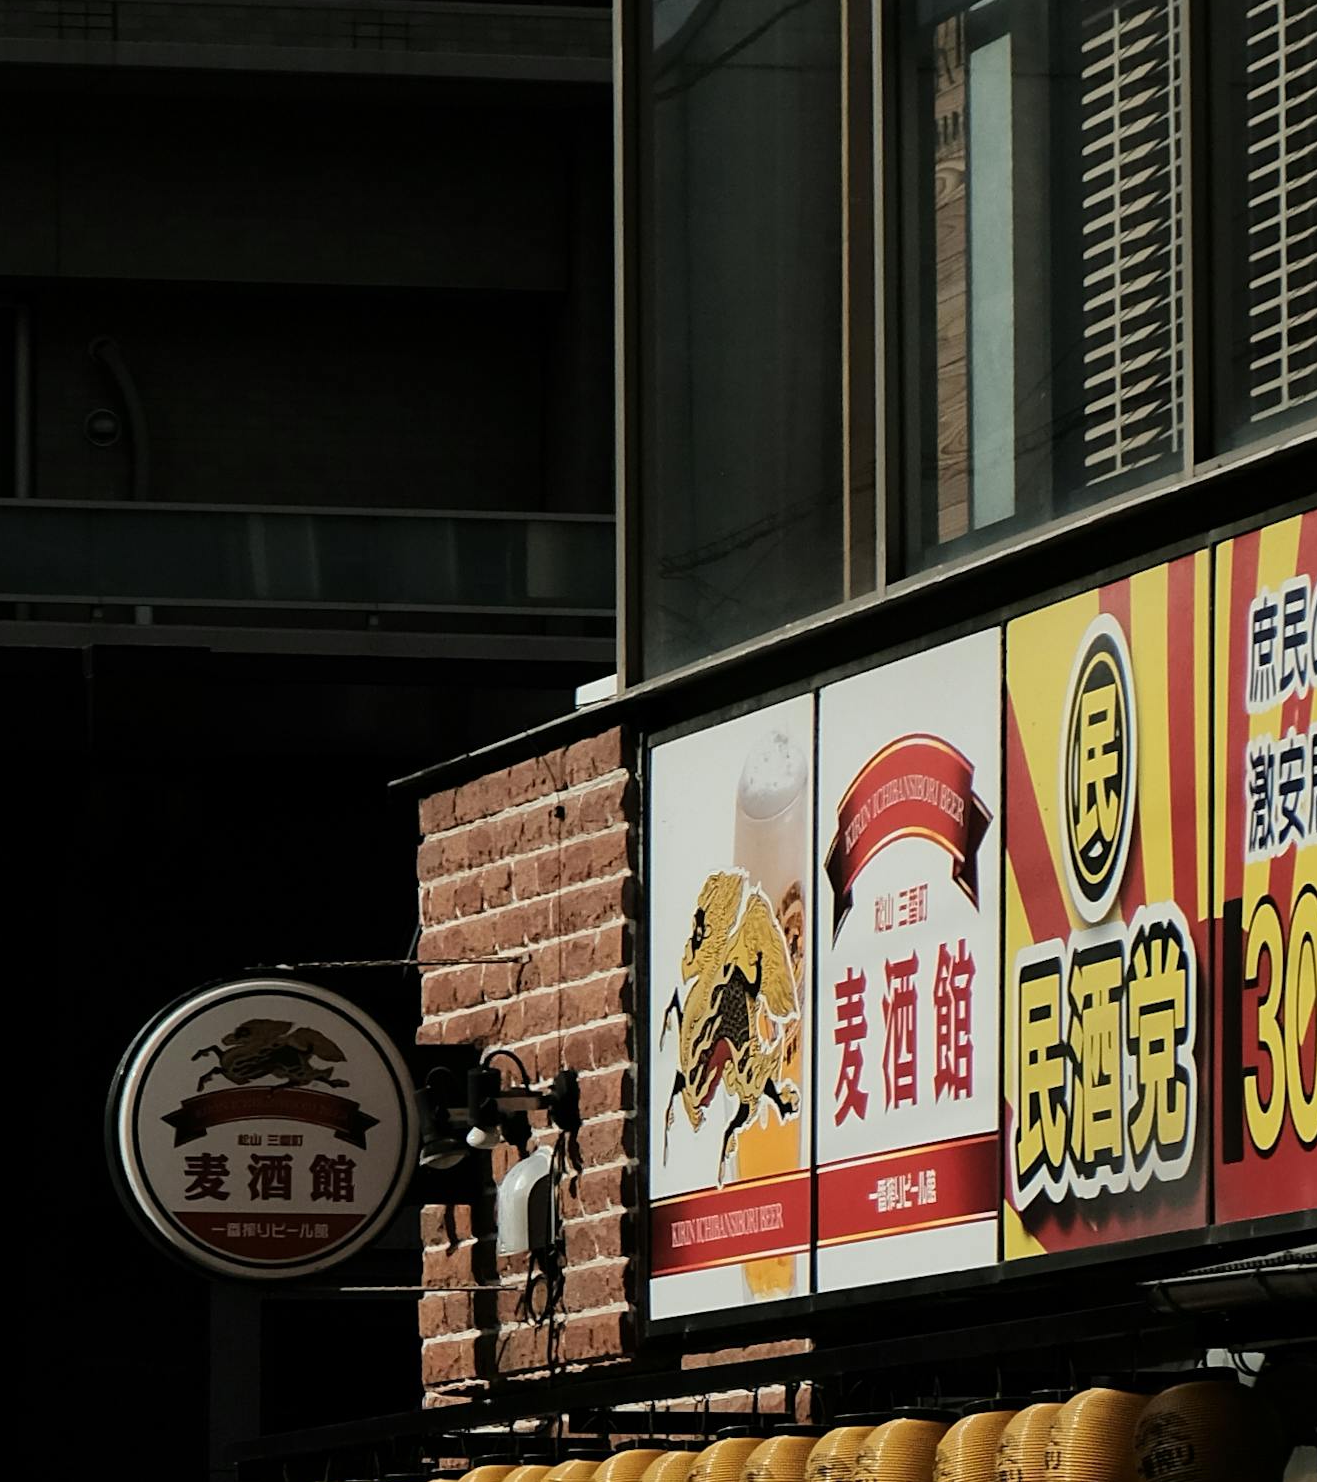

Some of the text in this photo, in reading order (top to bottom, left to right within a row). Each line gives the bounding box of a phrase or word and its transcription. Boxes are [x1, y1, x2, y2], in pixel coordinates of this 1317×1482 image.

[1074, 687, 1122, 840] 民
[845, 799, 872, 855] KIRIN
[939, 784, 965, 828] BEER
[833, 937, 975, 1130] 麦酒館
[1016, 936, 1188, 1163] 民酒党
[184, 1153, 356, 1202] 麦酒館
[211, 1222, 329, 1239] 一番搾りビール館
[759, 1203, 783, 1233] BEER
